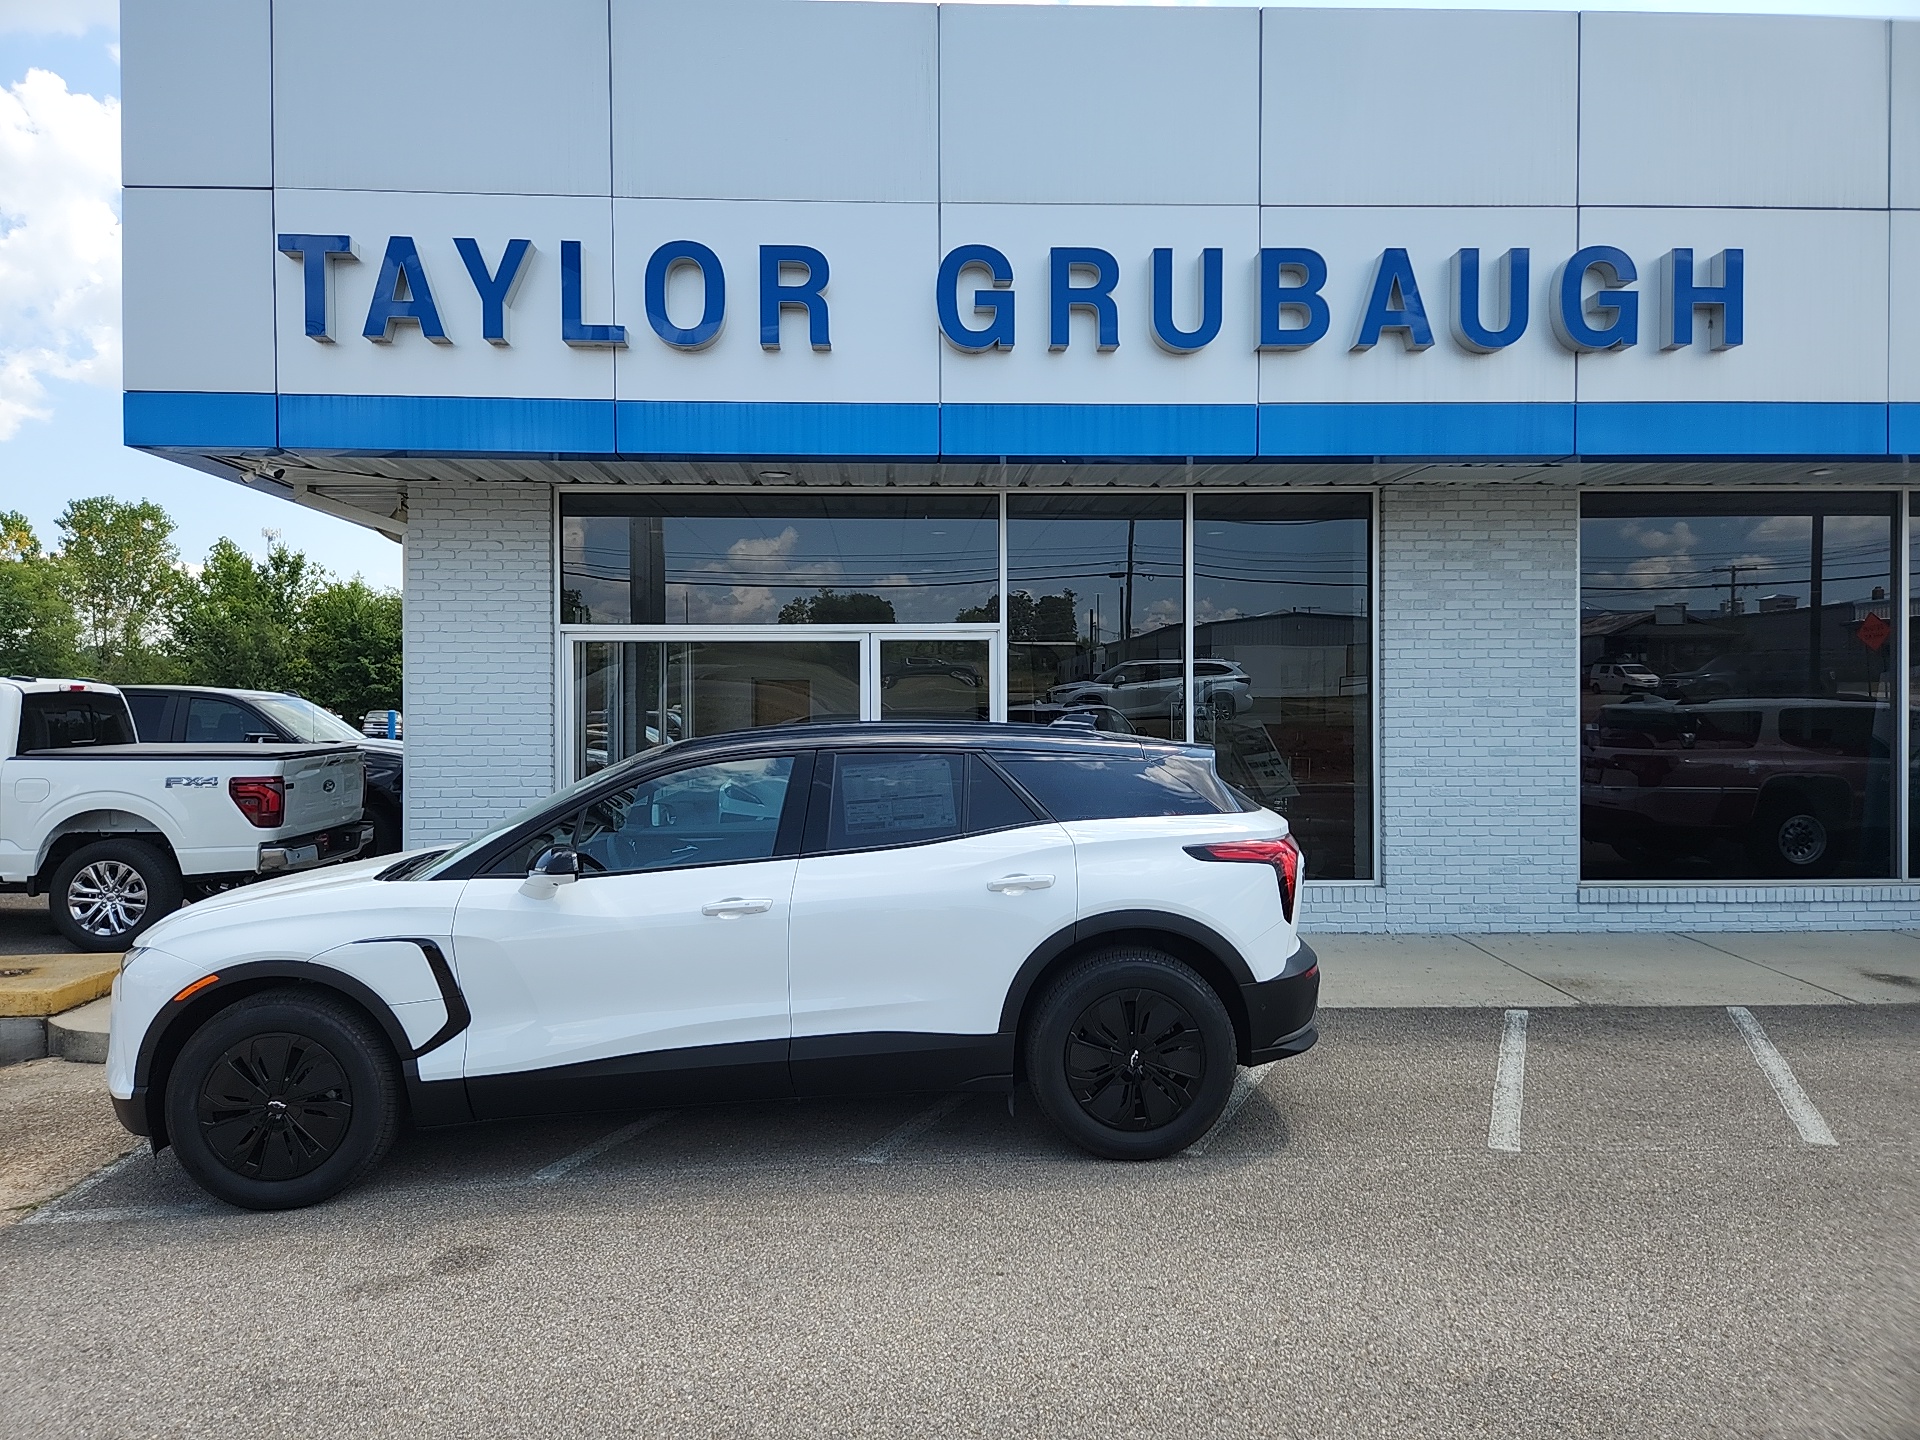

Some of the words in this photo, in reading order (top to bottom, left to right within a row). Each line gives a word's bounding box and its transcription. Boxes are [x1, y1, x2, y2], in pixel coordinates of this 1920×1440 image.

[278, 233, 833, 352] TAYLOR
[936, 243, 1744, 355] GRUBAUGH
[165, 776, 219, 788] FX4
